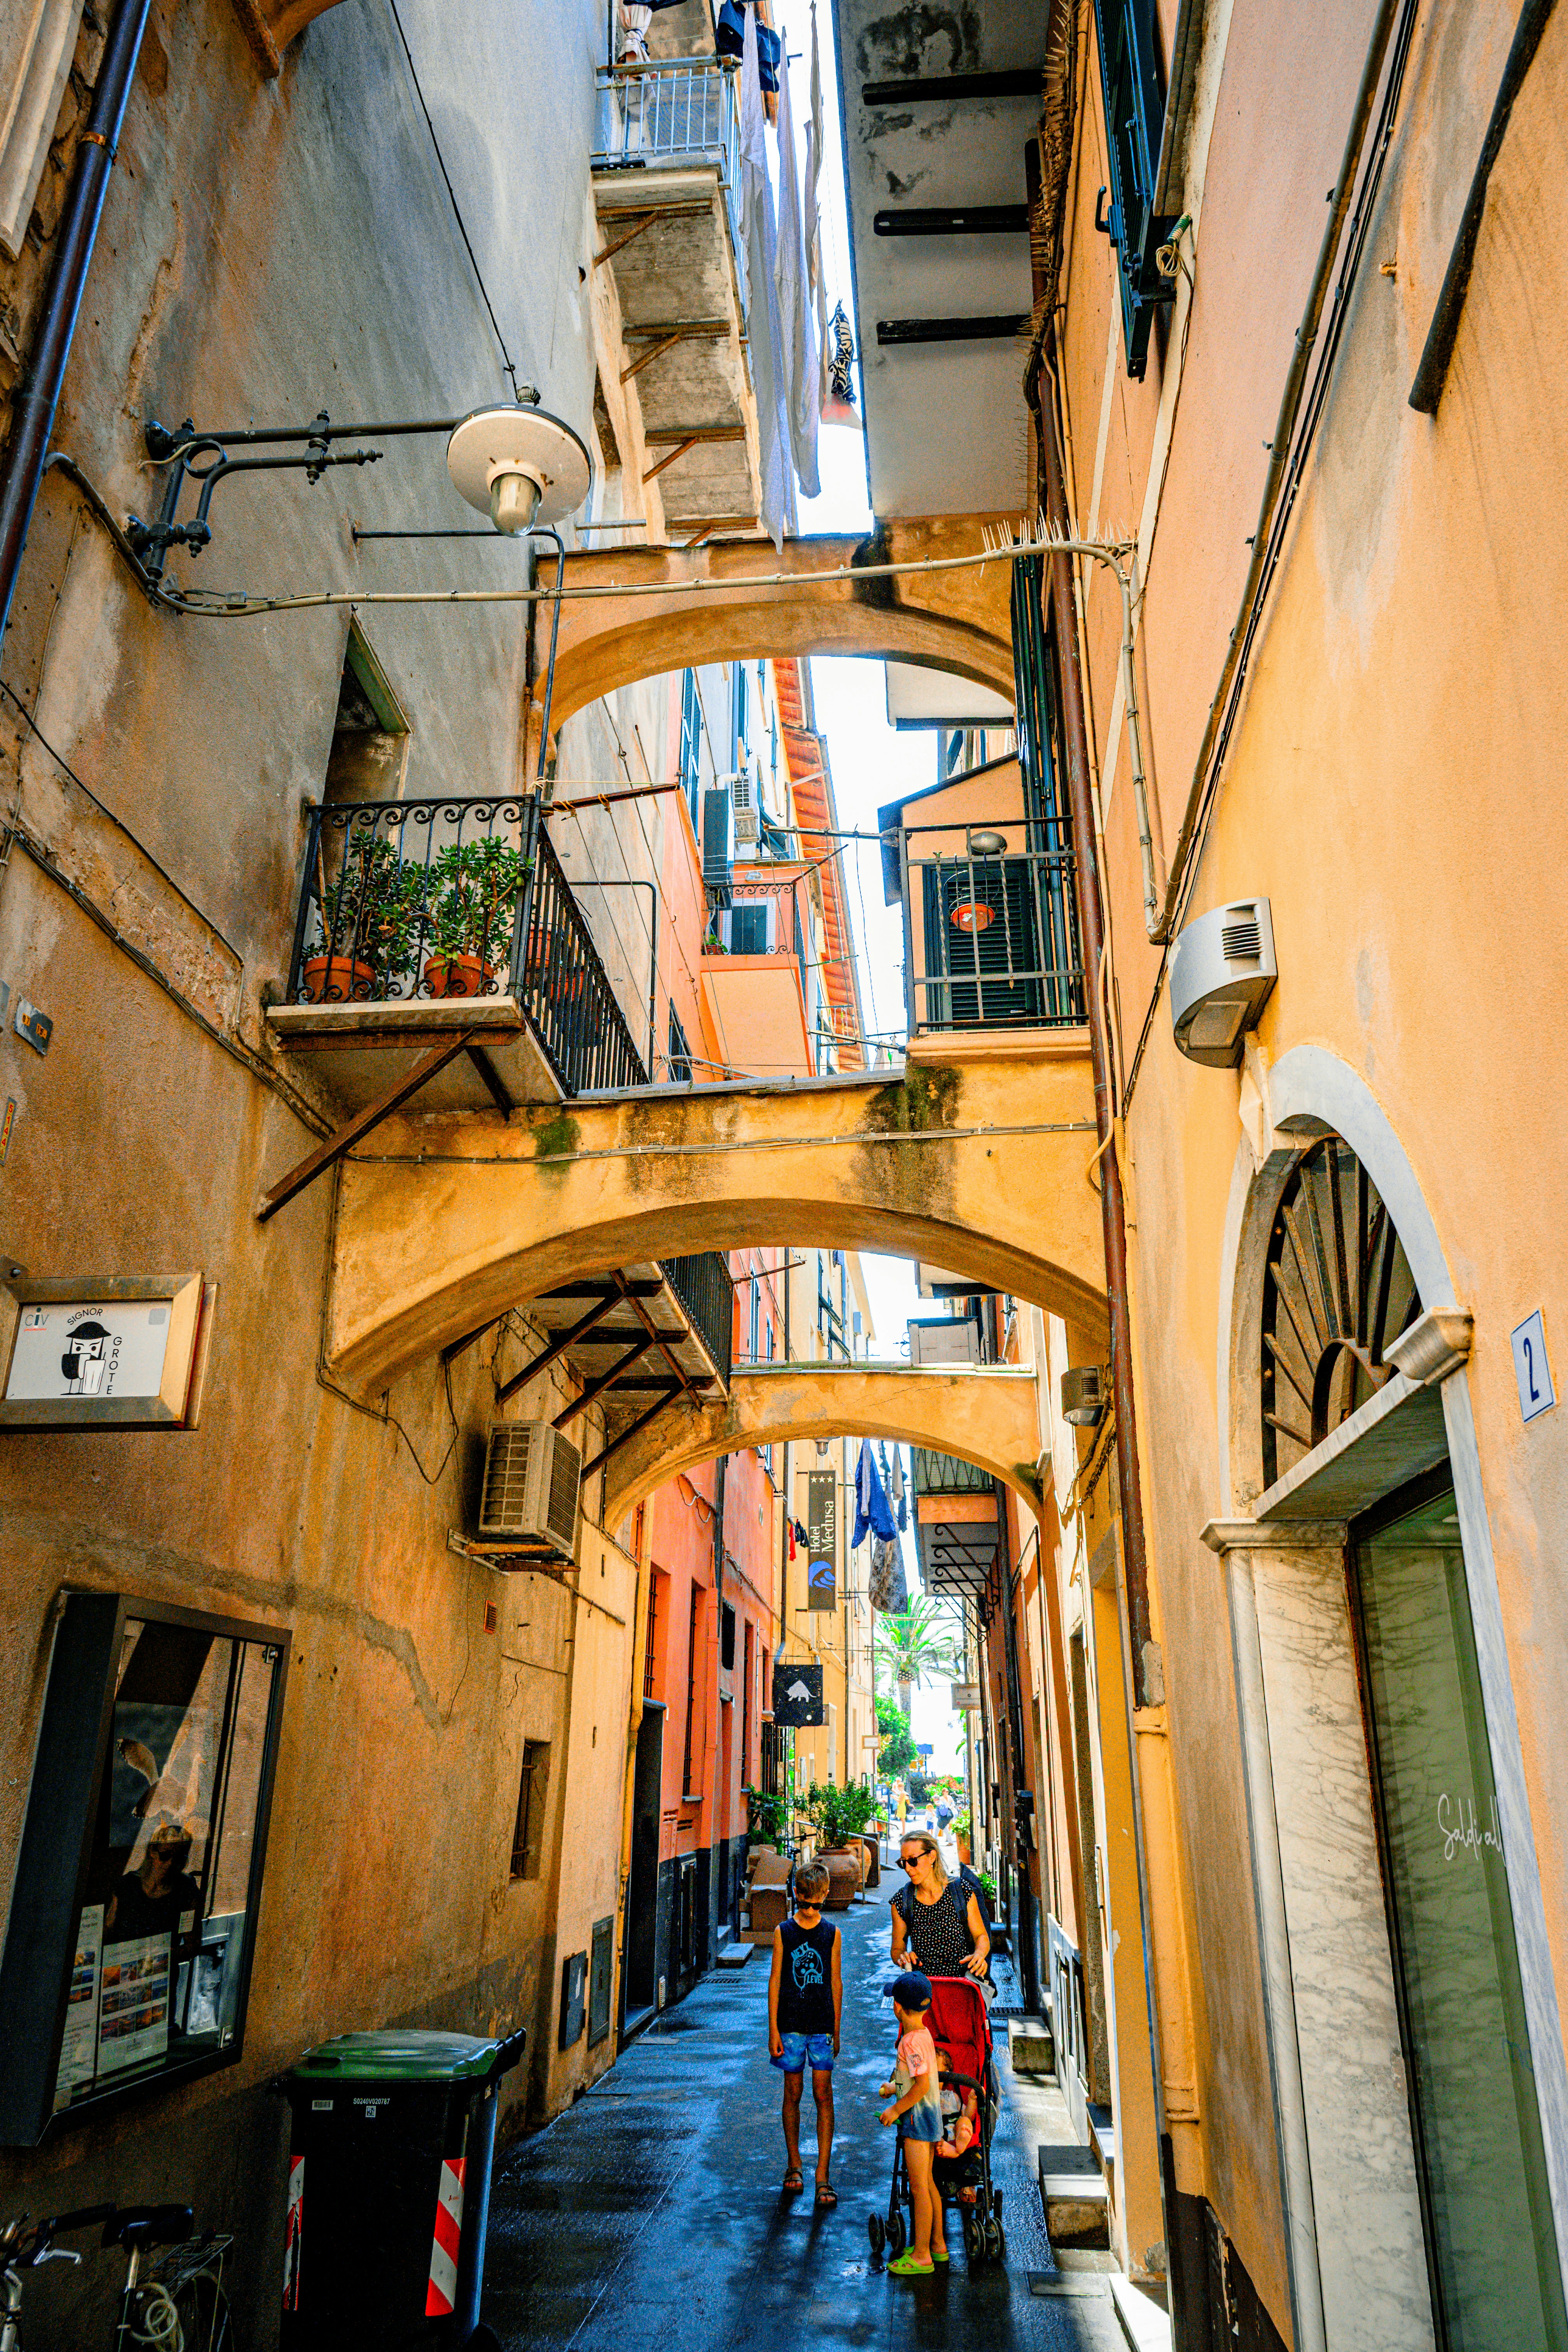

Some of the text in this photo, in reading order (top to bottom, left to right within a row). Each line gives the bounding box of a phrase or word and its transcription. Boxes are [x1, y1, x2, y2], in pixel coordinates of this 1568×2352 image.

[67, 1308, 103, 1325] SIGNOR
[107, 1337, 122, 1395] GROTE
[1523, 1337, 1540, 1402] 2
[810, 1526, 820, 1553] Hotel
[821, 1500, 834, 1553] Medusa
[1438, 1794, 1482, 1861] Saldi
[791, 1941, 809, 1959] NEXT
[807, 1974, 823, 1984] LEVEL
